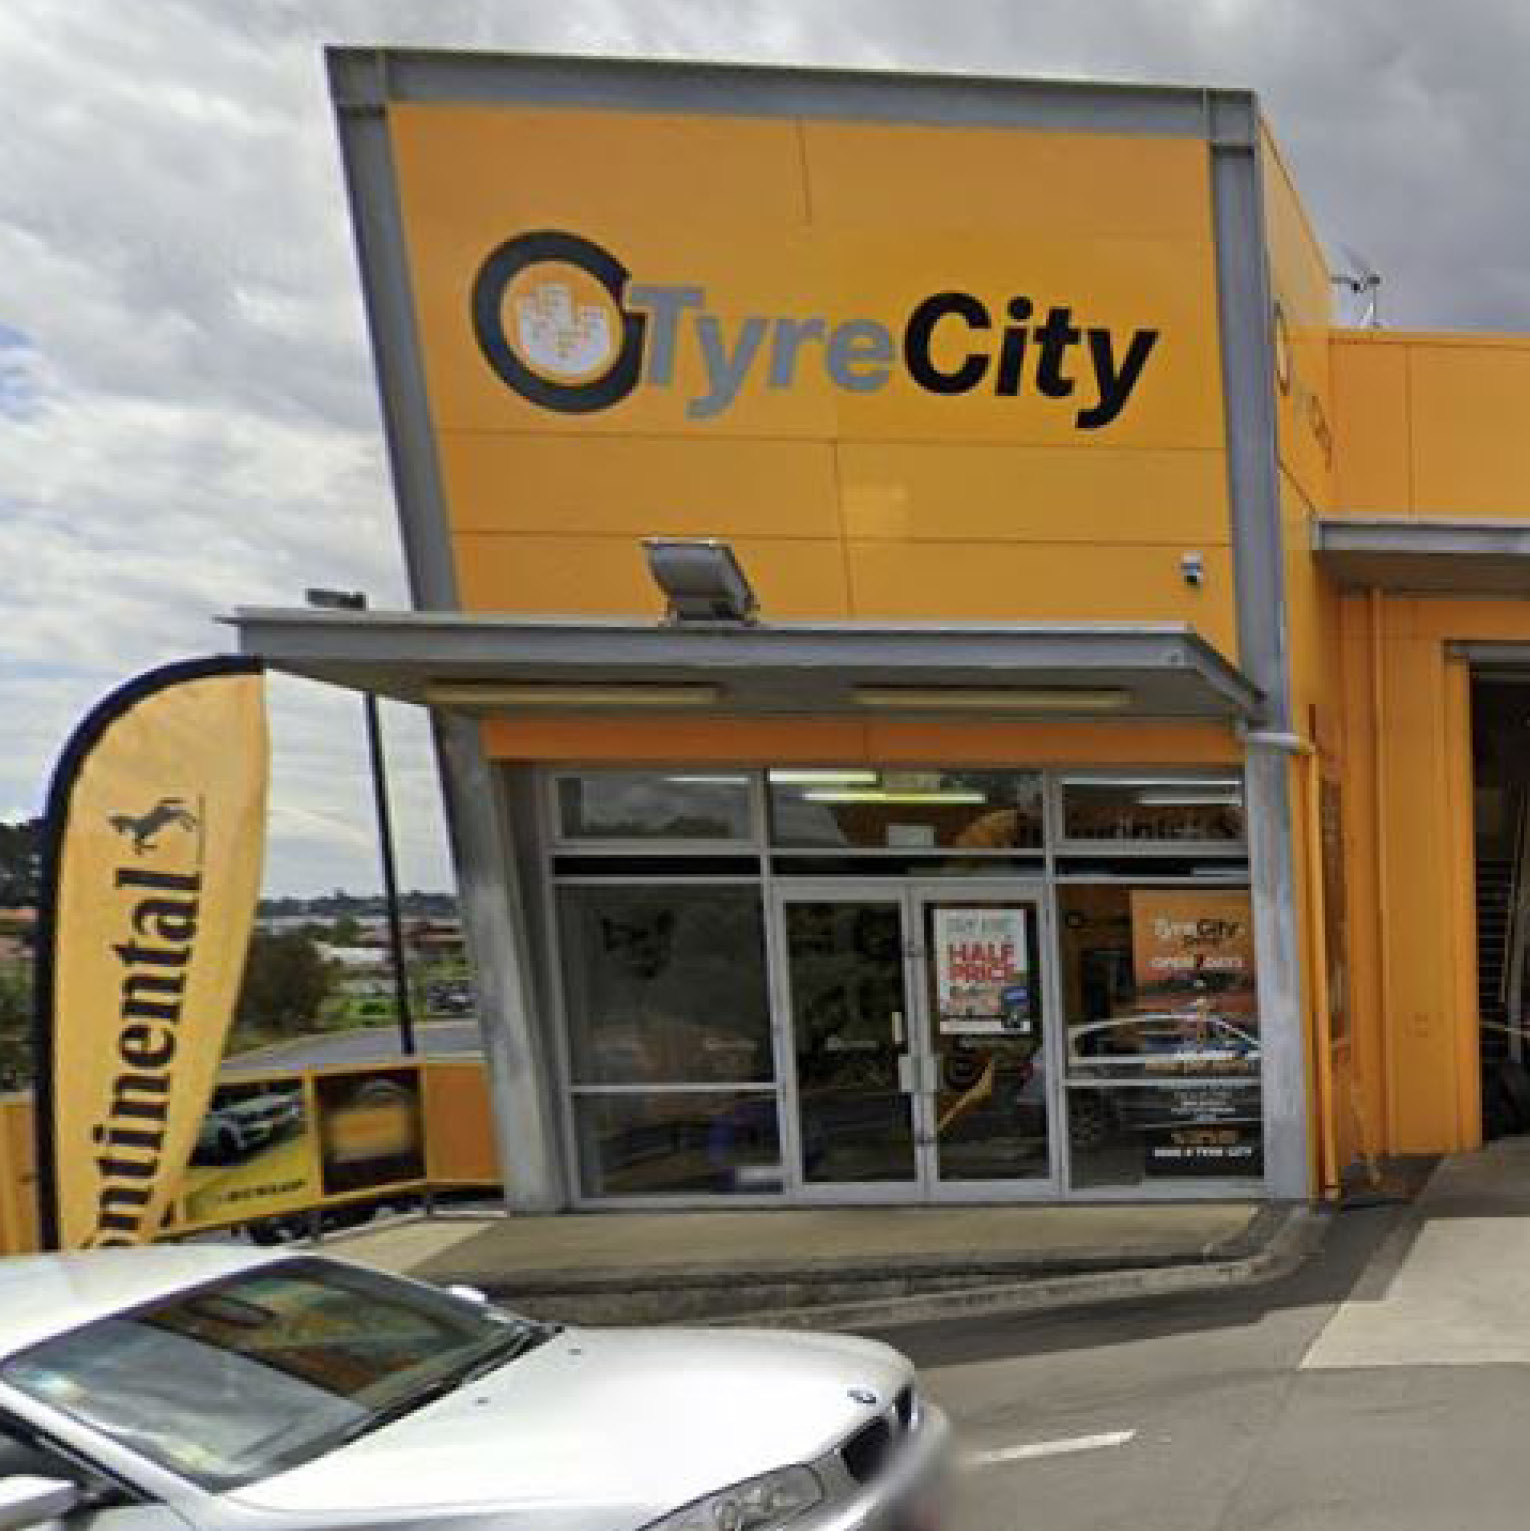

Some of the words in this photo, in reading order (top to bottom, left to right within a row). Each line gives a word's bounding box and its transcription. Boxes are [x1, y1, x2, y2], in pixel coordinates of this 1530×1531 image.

[627, 279, 1160, 429] TyreCity
[947, 941, 1015, 961] HALF
[947, 962, 1017, 984] PRICE
